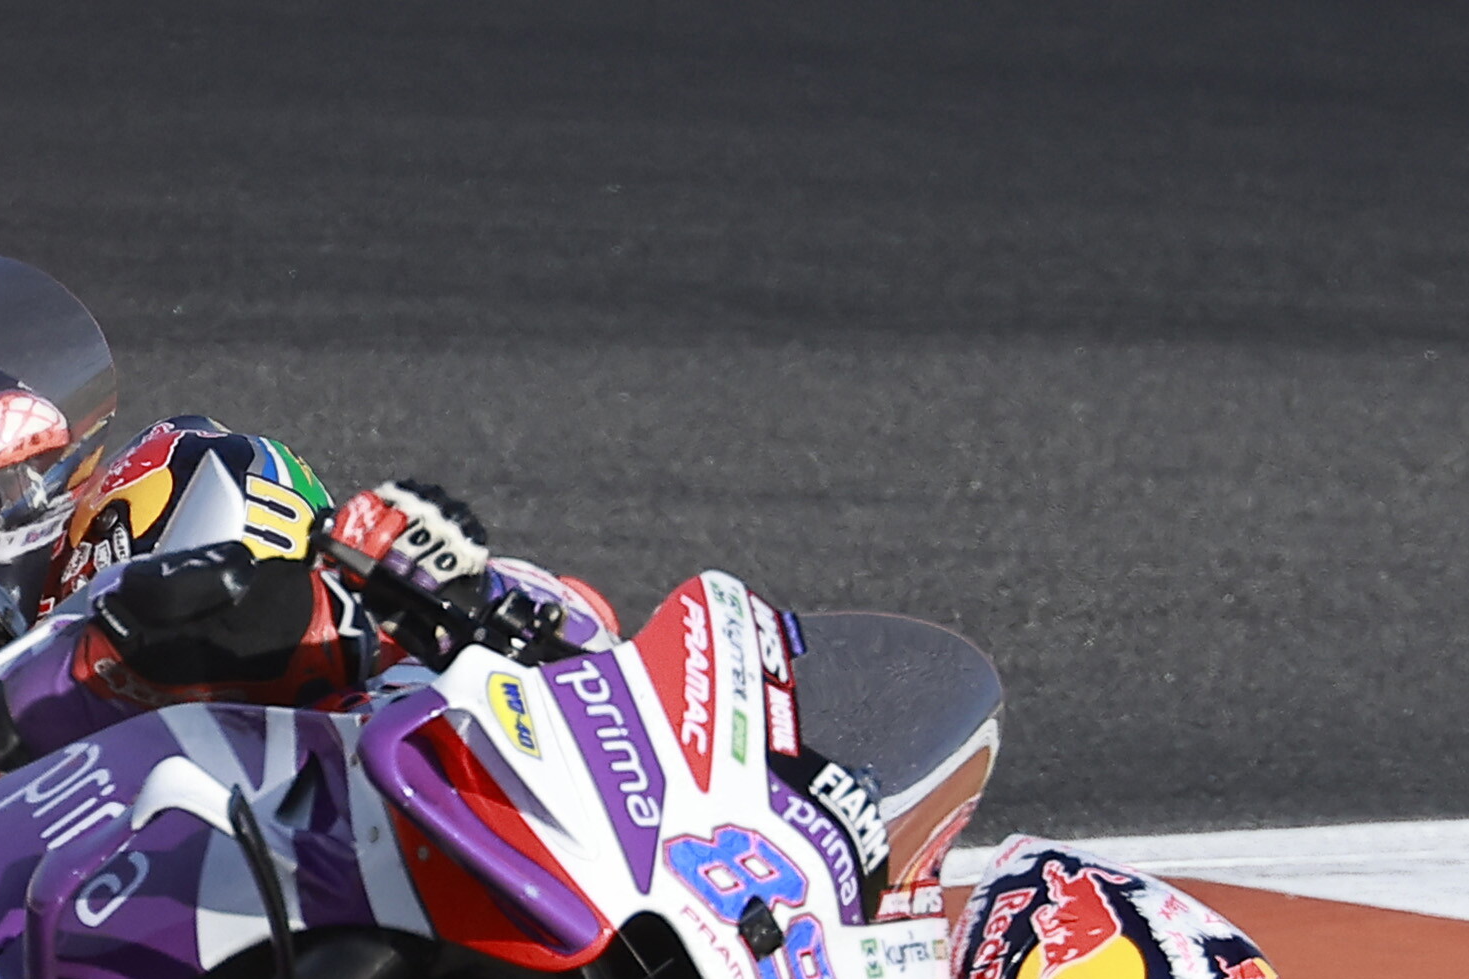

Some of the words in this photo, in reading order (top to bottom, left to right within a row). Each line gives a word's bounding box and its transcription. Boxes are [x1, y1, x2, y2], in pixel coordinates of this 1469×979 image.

[500, 681, 536, 750] WD-40
[680, 593, 710, 755] PRAMAC
[555, 660, 661, 828] prima
[783, 795, 860, 907] prima
[808, 762, 890, 876] FIAMM
